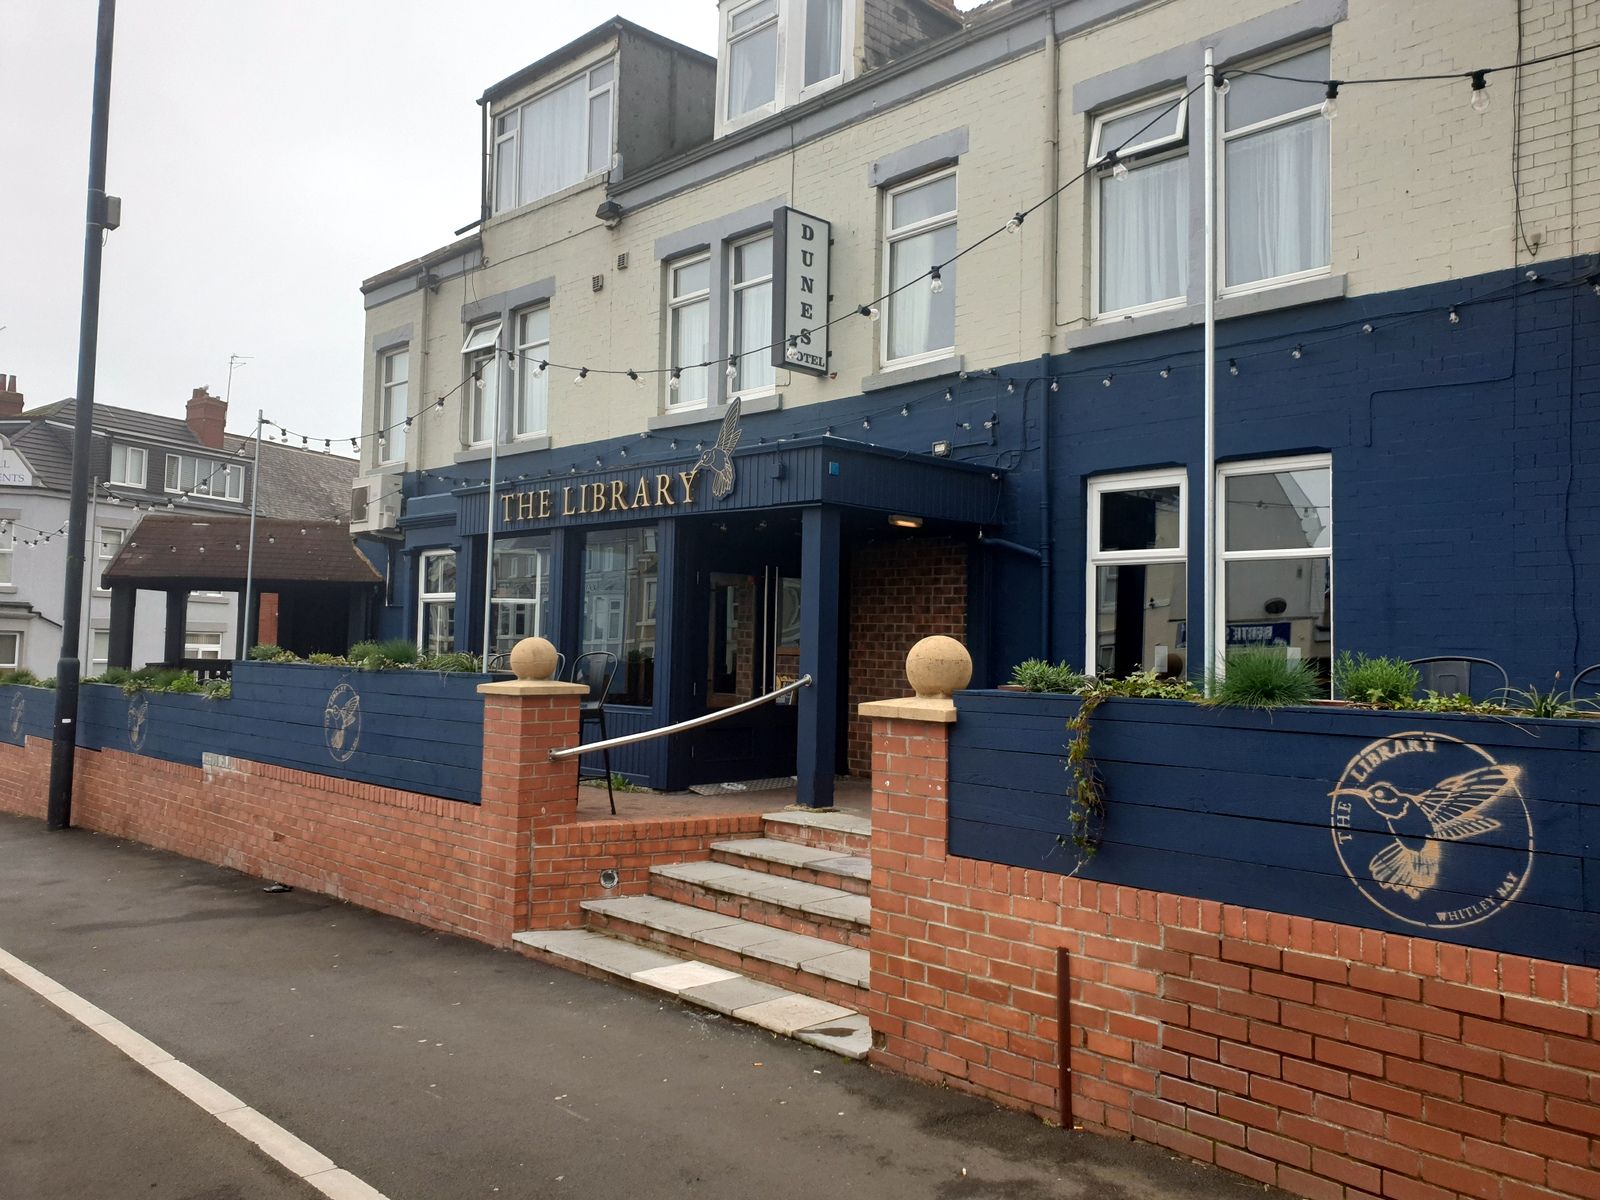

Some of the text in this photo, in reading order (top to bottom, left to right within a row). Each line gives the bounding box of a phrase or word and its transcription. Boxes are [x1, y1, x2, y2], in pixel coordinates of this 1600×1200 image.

[800, 223, 814, 345] DUNES
[787, 348, 825, 367] OTEL
[501, 470, 699, 522] THE LIBRARY
[1337, 736, 1437, 845] THE LIBRARY
[1435, 895, 1496, 922] WHITLEY
